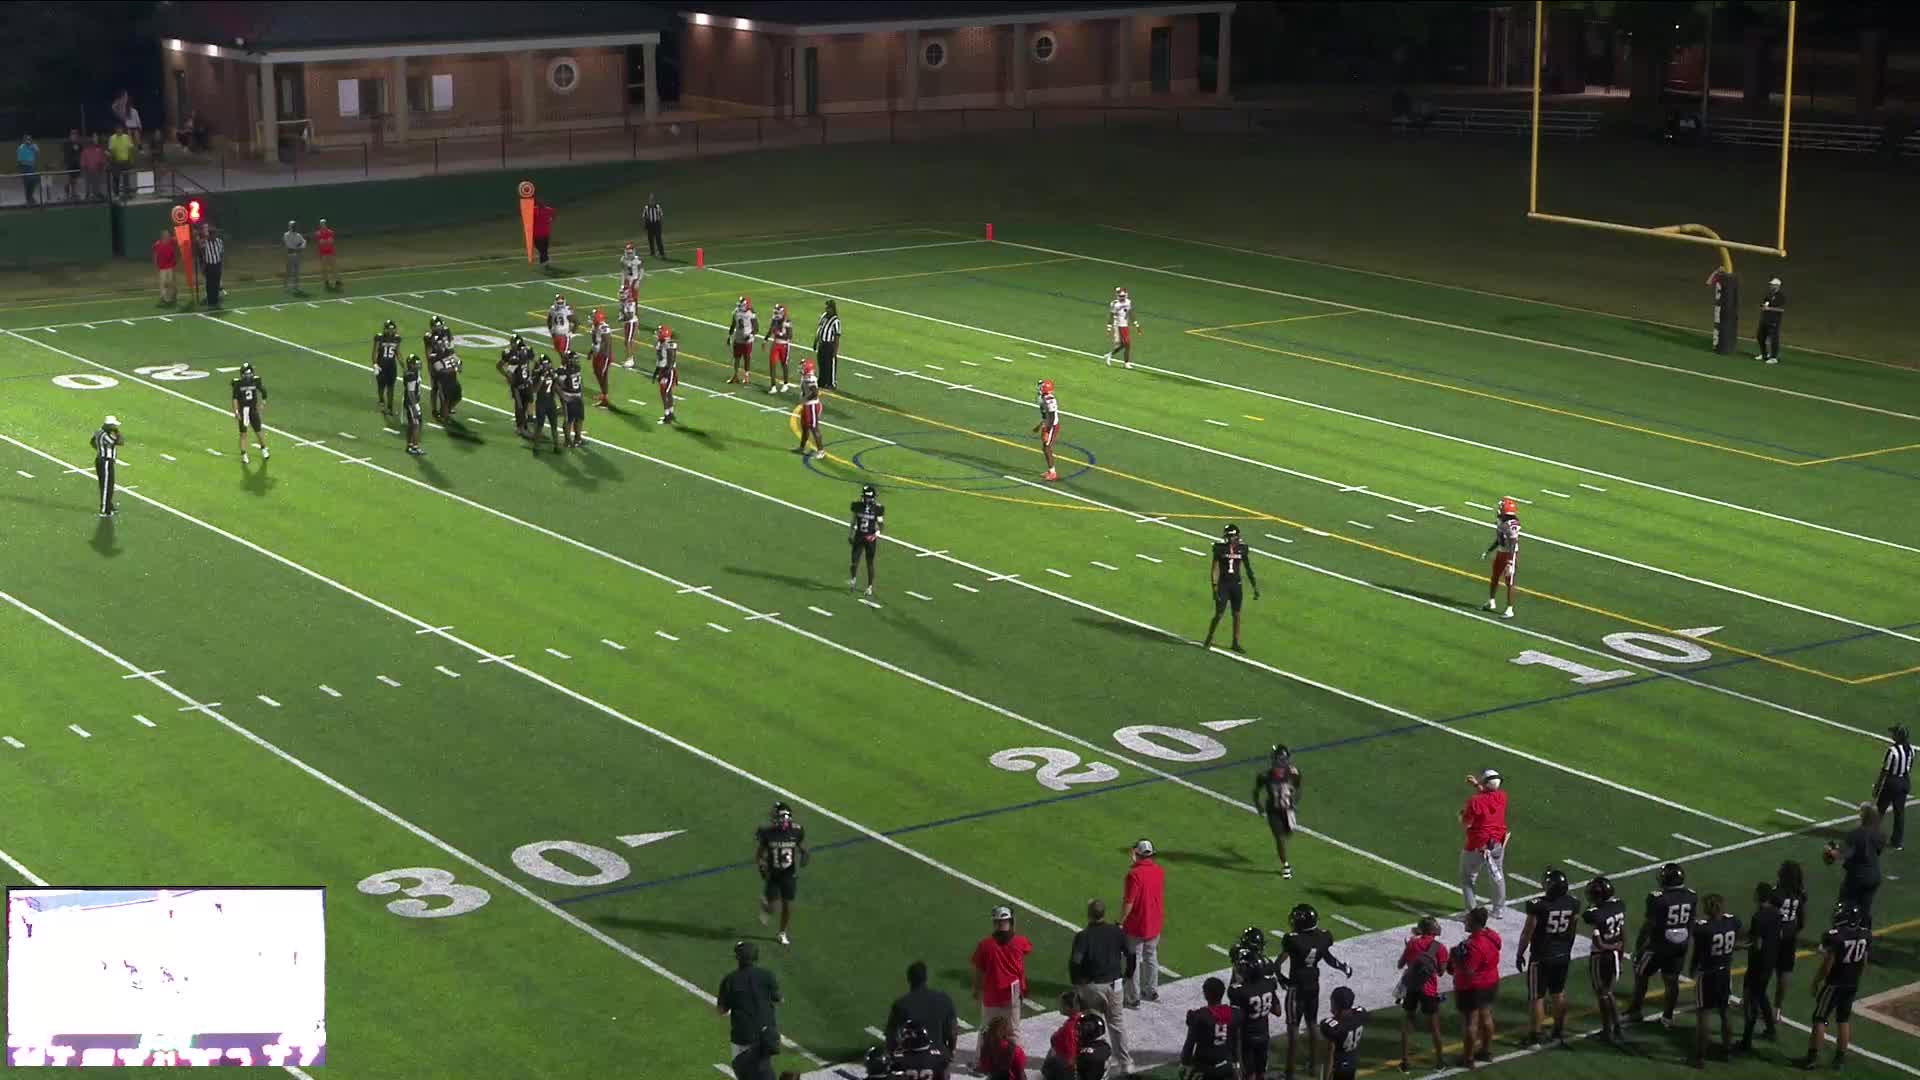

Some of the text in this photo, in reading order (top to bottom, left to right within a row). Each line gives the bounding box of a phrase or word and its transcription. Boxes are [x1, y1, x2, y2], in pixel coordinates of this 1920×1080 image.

[189, 201, 200, 220] 2
[51, 363, 210, 390] 20
[545, 379, 553, 393] 7
[1227, 558, 1235, 574] 1
[1509, 632, 1712, 685] 10
[989, 724, 1227, 791] 20
[773, 847, 793, 869] 13
[356, 840, 631, 918] 30
[1547, 909, 1574, 934] 55
[1666, 903, 1692, 926] 56
[1710, 930, 1737, 956] 28
[1843, 938, 1868, 964] 70
[1304, 948, 1318, 968] 4
[1249, 992, 1274, 1020] 38
